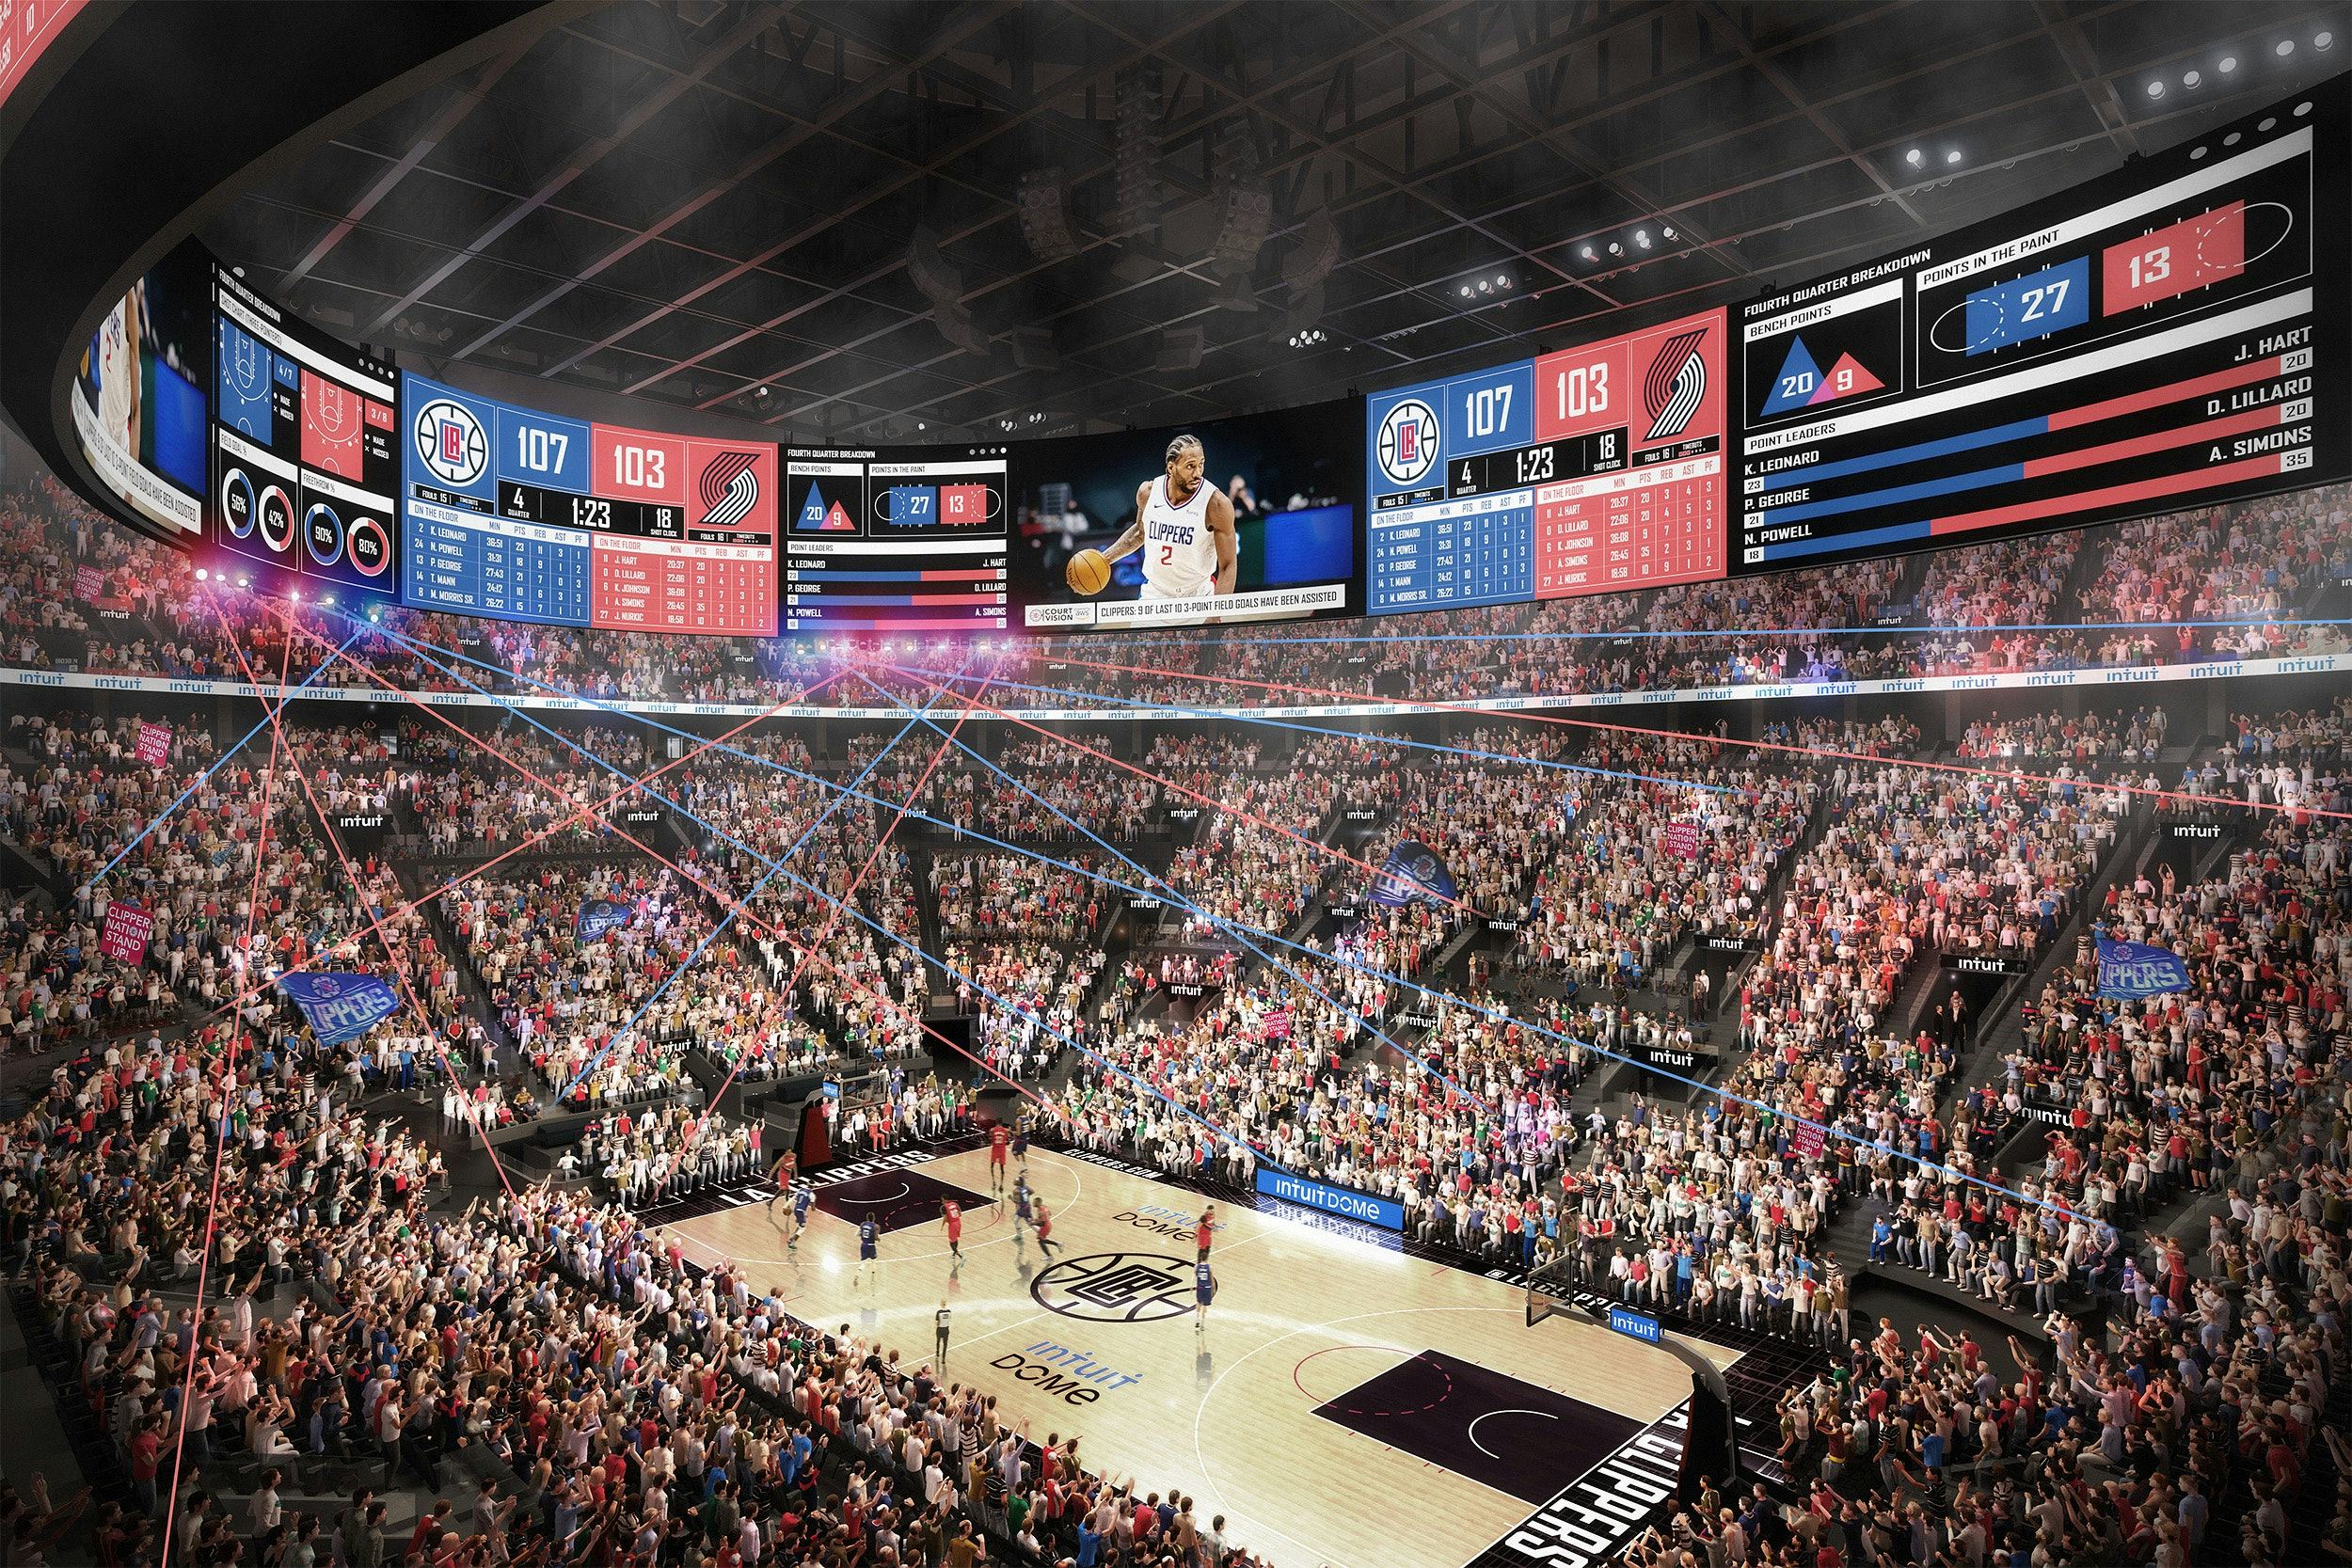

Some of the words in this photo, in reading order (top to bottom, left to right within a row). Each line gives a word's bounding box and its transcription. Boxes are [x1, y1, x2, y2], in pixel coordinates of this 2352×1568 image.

[1924, 261, 1969, 284] POINTS
[1974, 256, 1987, 269] IN
[1992, 245, 2015, 262] THE
[2020, 230, 2059, 252] PAINT
[2128, 245, 2170, 289] 13
[1744, 294, 1789, 317] FOURTH
[1793, 277, 1848, 303] QUARTER
[1851, 249, 1931, 285] BREAKDOWN
[2022, 279, 2070, 323] 27
[1751, 319, 1787, 337] BENCH
[1790, 306, 1832, 325] POINTS
[2234, 344, 2252, 361] J.
[2259, 325, 2312, 355] HART
[2286, 354, 2306, 369] 20
[1782, 372, 1812, 398] 20
[1837, 368, 1852, 391] 9
[1557, 361, 1608, 420] 103
[2208, 400, 2225, 416] D.
[2232, 376, 2312, 409] LILLARD
[372, 408, 388, 422] 3/8
[1465, 385, 1514, 438] 107
[2286, 403, 2306, 418] 20
[1751, 435, 1782, 450] POINT
[1787, 423, 1836, 442] LEADERS
[2210, 447, 2227, 462] A.
[2233, 426, 2312, 456] SIMONS
[518, 426, 568, 475] 107
[787, 449, 811, 457] FOURTH
[812, 450, 839, 458] QUARTER
[840, 451, 876, 459] BREAKDOWN
[1599, 434, 1615, 460] 18
[1645, 452, 1660, 463] FOULS
[1662, 449, 1670, 459] 16
[613, 444, 665, 489] 103
[1516, 447, 1553, 483] 1:23
[1594, 463, 1605, 471] SHOT
[1606, 459, 1621, 469] CLOCK
[1744, 464, 1756, 475] K.
[1760, 451, 1820, 472] LEONARD
[2287, 452, 2307, 467] 35
[1461, 461, 1472, 484] 4
[1613, 478, 1625, 488] MIN
[1639, 472, 1651, 484] PTS
[1661, 468, 1674, 480] REB
[1683, 465, 1694, 475] AST
[1705, 461, 1712, 471] PF
[1456, 484, 1477, 496] QUARTER
[1748, 481, 1760, 490] 23
[231, 494, 246, 514] 56%
[422, 490, 437, 500] FOULS
[440, 494, 447, 503] 15
[514, 487, 524, 508] 4
[911, 496, 930, 514] 27
[949, 496, 963, 513] 13
[1558, 507, 1564, 517] J.
[1565, 504, 1581, 516] HART
[1611, 497, 1629, 508] 20:37
[1641, 493, 1649, 503] 20
[1744, 499, 1755, 510] P.
[1759, 488, 1810, 508] GEORGE
[269, 510, 284, 529] 42%
[414, 504, 423, 515] ON
[425, 506, 437, 517] THE
[438, 510, 458, 522] FLOOR
[507, 508, 530, 519] QUARTER
[572, 498, 611, 529] 1:23
[657, 508, 671, 529] 18
[806, 506, 822, 521] 20
[834, 512, 841, 526] 9
[1749, 516, 1759, 525] 21
[315, 526, 332, 544] 90%
[419, 523, 423, 532] 2
[430, 526, 437, 535] K.
[437, 527, 467, 542] LEONARD
[489, 521, 501, 531] MIN
[514, 526, 526, 535] PTS
[534, 529, 546, 538] REB
[555, 532, 566, 541] AST
[1149, 521, 1194, 546] CLIPPERS
[1744, 533, 1756, 545] N.
[1761, 525, 1812, 543] POWELL
[358, 538, 377, 555] 80%
[414, 538, 423, 548] 24
[430, 542, 437, 551] N.
[438, 542, 463, 557] POWELL
[1160, 546, 1172, 565] 2
[1750, 550, 1759, 559] 18
[1101, 607, 1136, 617] CLIPPERS:
[1138, 606, 1143, 614] 9
[1145, 605, 1153, 614] OF
[1155, 603, 1173, 613] LAST
[1175, 603, 1183, 612] 10
[1184, 601, 1213, 612] 3-POINT
[1215, 600, 1233, 610] FIELD
[1235, 597, 1259, 609] GOALS
[1260, 596, 1279, 607] HAVE
[1280, 594, 1299, 605] BEEN
[1301, 592, 1337, 603] ASSISTED
[141, 725, 170, 741] CLIPPER
[139, 743, 164, 757] STAND
[144, 753, 155, 764] UP!
[1667, 826, 1695, 835] CLIPPER
[1669, 841, 1692, 850] STAND
[1675, 849, 1686, 858] UP!
[108, 907, 151, 929] CLIPPER
[106, 931, 140, 950] STAND
[113, 945, 129, 959] UP!
[1062, 1149, 1164, 1179] CLIPPERS.COM
[719, 1189, 775, 1206] LA
